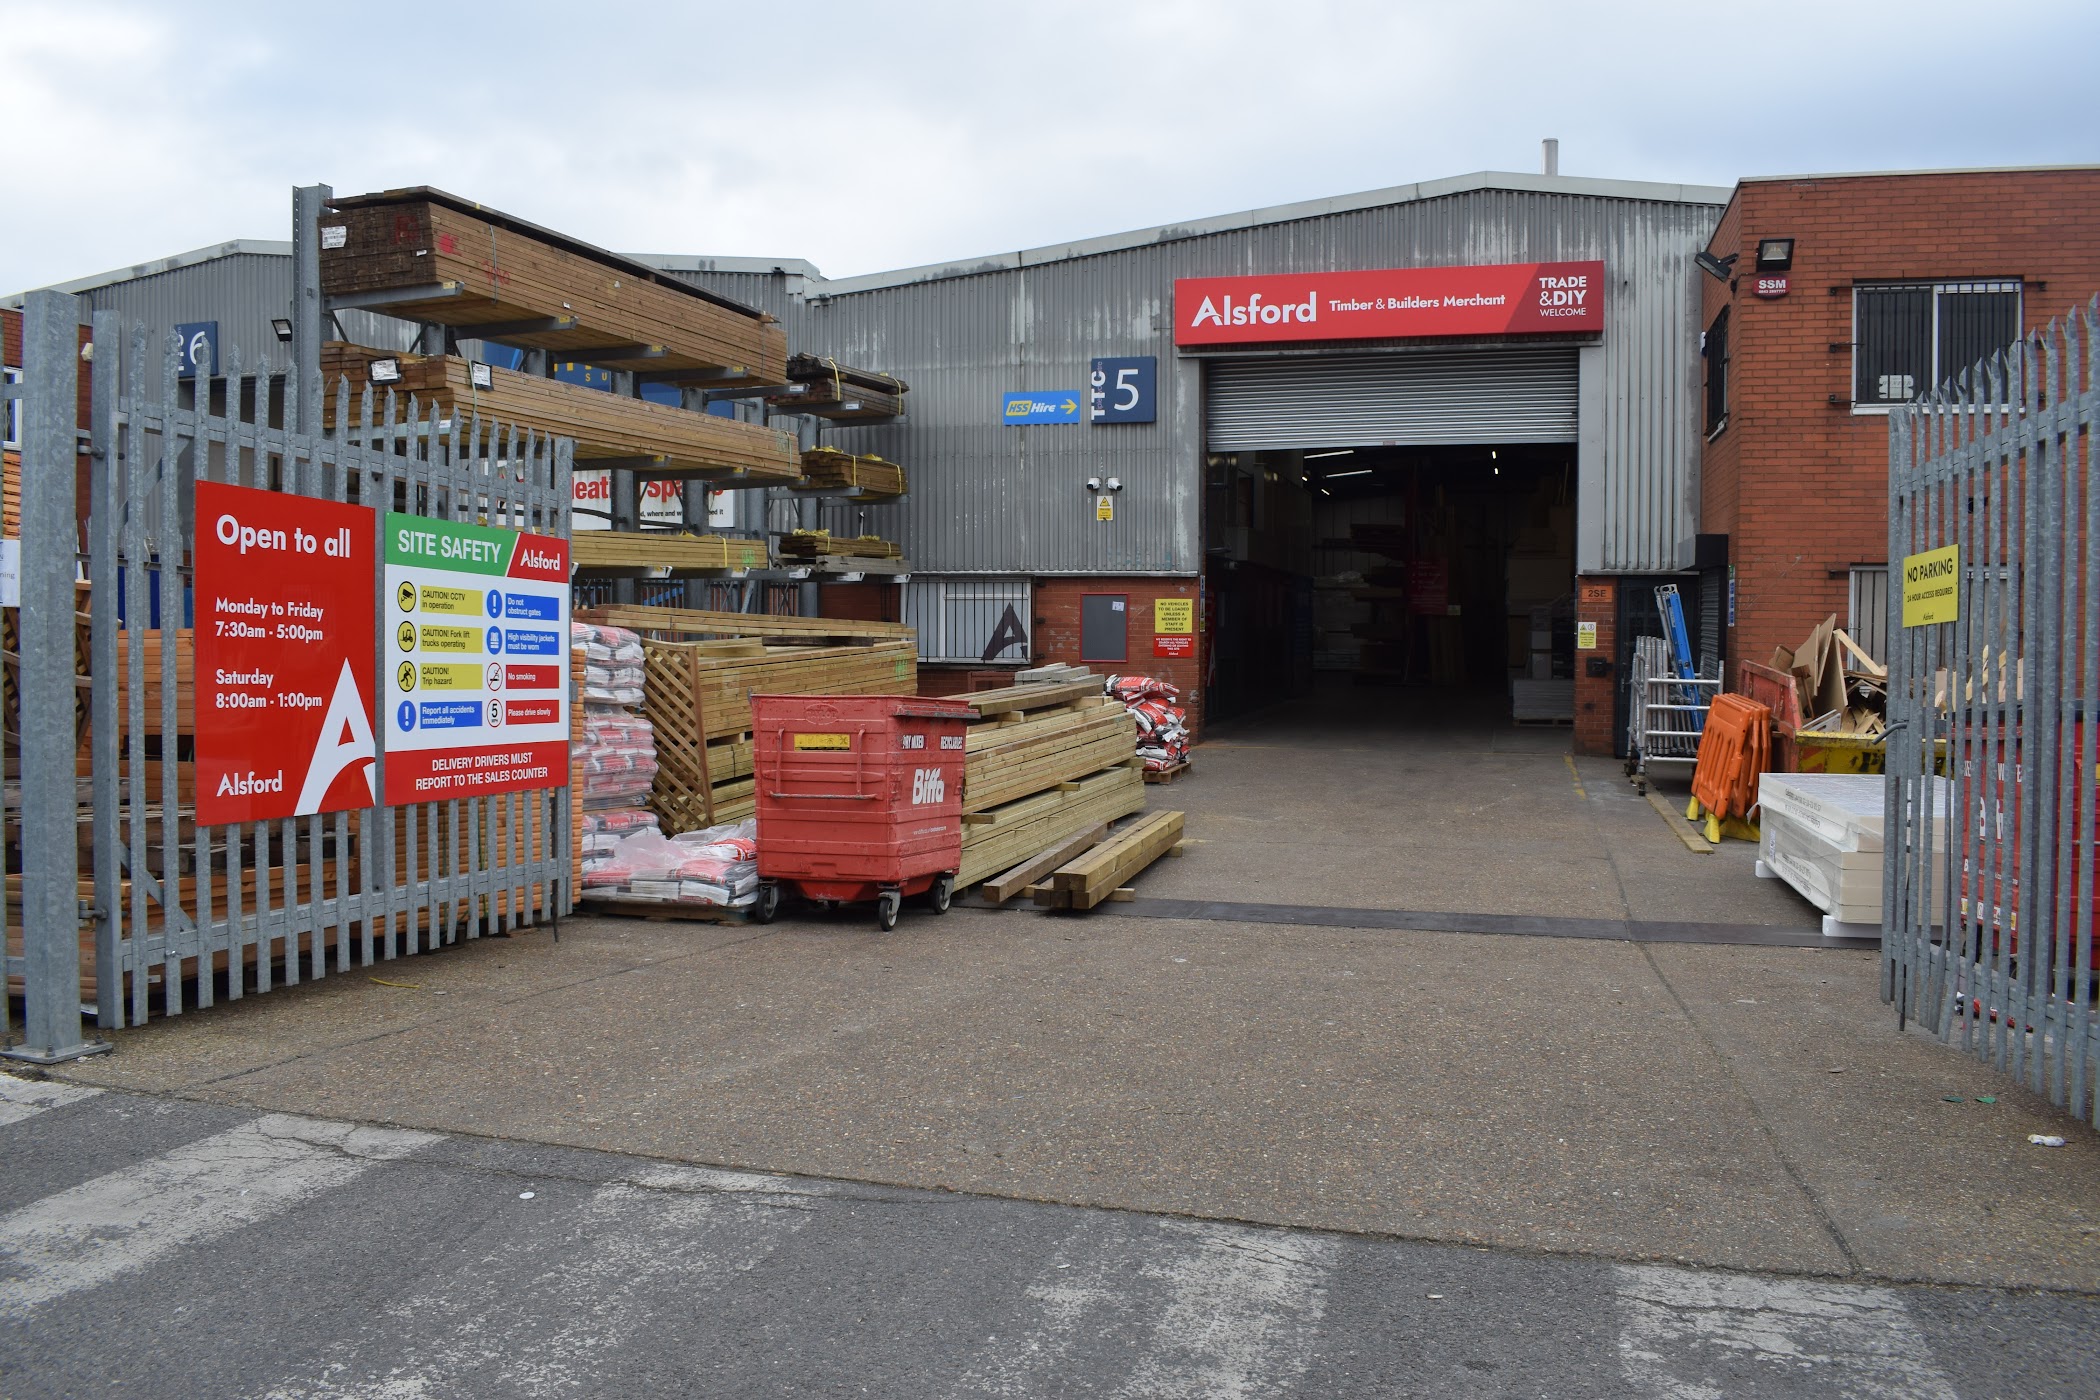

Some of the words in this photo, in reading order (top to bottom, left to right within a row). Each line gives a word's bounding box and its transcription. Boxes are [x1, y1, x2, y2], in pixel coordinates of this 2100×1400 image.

[1539, 275, 1587, 289] TRADE
[1758, 279, 1787, 289] SSM
[1539, 289, 1588, 306] &DIY
[1191, 291, 1317, 327] Alsford
[1329, 299, 1374, 312] Timber
[1375, 299, 1386, 310] &
[1387, 296, 1440, 309] Builders
[1443, 293, 1506, 308] Merchant
[1539, 306, 1587, 317] WELCOME
[1113, 368, 1139, 411] 5
[1009, 402, 1029, 413] HSS
[1030, 402, 1056, 413] Hire
[216, 514, 287, 554] Open
[294, 527, 317, 554] to
[324, 527, 350, 558] all
[398, 529, 437, 557] SITE
[440, 535, 502, 564] SAFETY
[519, 548, 561, 571] Alsford
[1907, 566, 1918, 583] NO
[1920, 558, 1953, 581] PARKING
[422, 590, 450, 599] CAUTION!
[450, 592, 466, 601] CCTV
[1588, 589, 1607, 598] 2SE
[1911, 593, 1921, 602] HOUR
[1921, 590, 1935, 600] ACCESS
[1934, 586, 1953, 597] REQUIRED
[422, 601, 428, 609] in
[428, 602, 455, 611] operation
[507, 597, 516, 605] Do
[516, 598, 524, 606] not
[215, 597, 269, 619] Monday
[271, 602, 284, 616] to
[287, 602, 324, 622] Friday
[507, 606, 528, 616] obstruct
[528, 608, 541, 617] gates
[215, 620, 266, 638] 7:30am
[276, 624, 323, 644] 5:00pm
[422, 628, 450, 638] CAUTION!
[450, 630, 462, 639] Fork
[462, 631, 470, 639] lift
[507, 632, 519, 642] High
[519, 633, 539, 643] visibility
[539, 635, 555, 643] jackets
[422, 639, 439, 648] trucks
[440, 641, 466, 649] operating
[507, 642, 520, 650] must
[422, 667, 450, 675] CAUTION!
[507, 672, 516, 680] No
[516, 672, 537, 681] smoking
[215, 668, 274, 688] Saturday
[422, 677, 432, 686] Trip
[433, 677, 453, 685] hazard
[215, 692, 267, 708] 8:00am
[277, 692, 323, 710] 1:00pm
[422, 706, 441, 716] Report
[441, 706, 449, 714] all
[449, 705, 475, 714] accidents
[491, 703, 498, 718] 5
[524, 709, 536, 717] drive
[536, 708, 551, 717] slowly
[422, 715, 456, 726] immediately
[432, 756, 474, 772] DELIVERY
[474, 753, 509, 768] DRIVERS
[510, 752, 533, 764] MUST
[216, 769, 283, 797] Alsford
[415, 775, 452, 791] REPORT
[453, 774, 466, 786] TO
[466, 773, 484, 785] THE
[484, 770, 510, 783] SALES
[511, 766, 548, 781] COUNTER
[912, 767, 945, 805] Biffa
